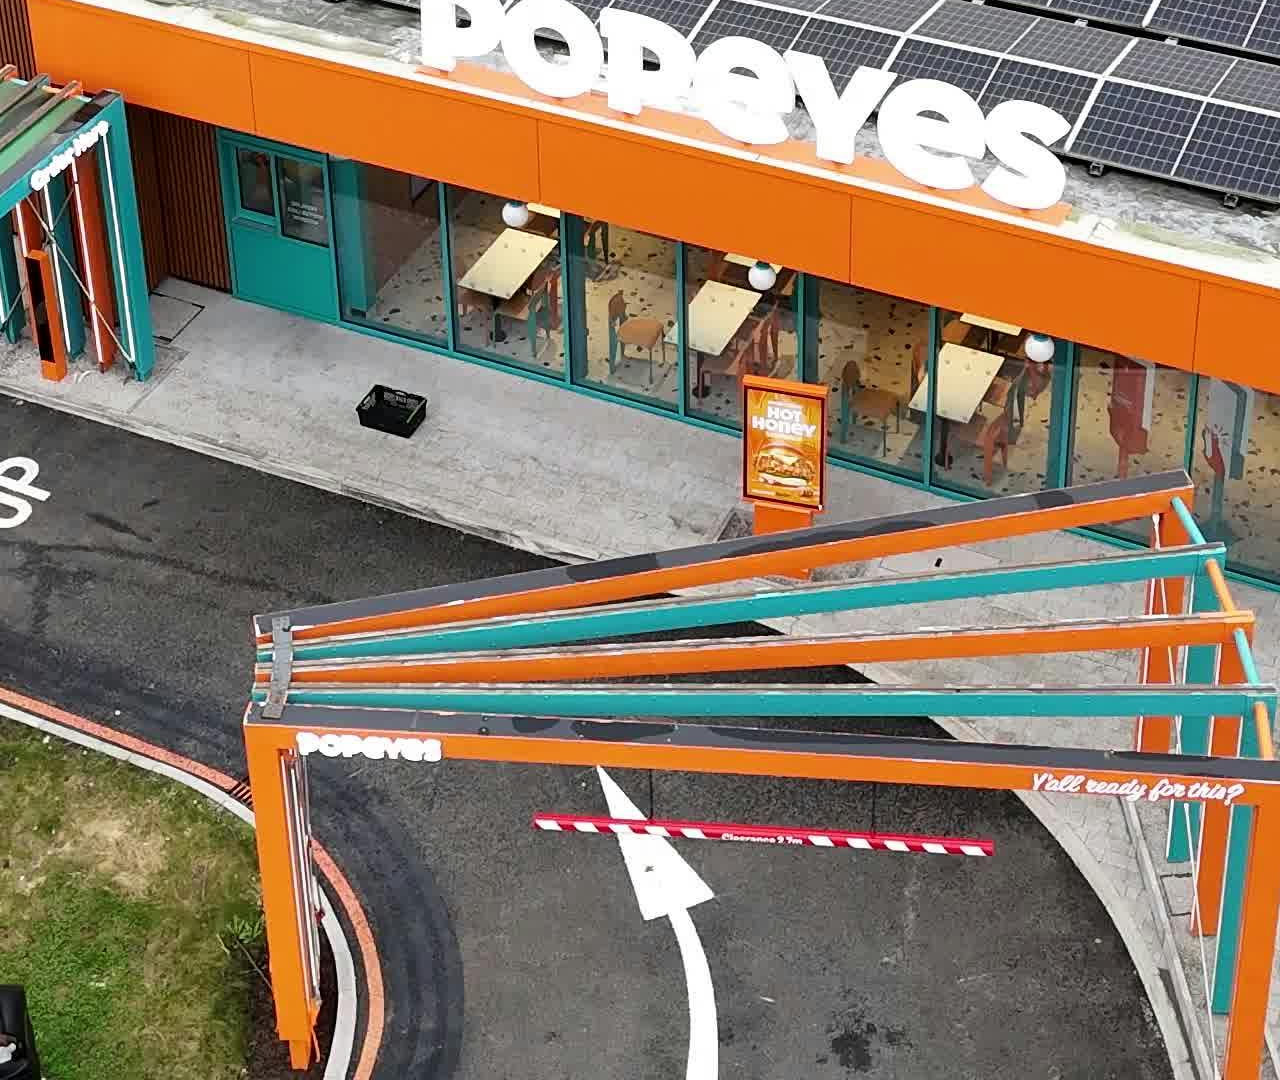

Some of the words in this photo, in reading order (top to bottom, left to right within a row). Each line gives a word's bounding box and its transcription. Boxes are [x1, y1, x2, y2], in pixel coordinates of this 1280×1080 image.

[767, 406, 801, 423] HOT
[1032, 773, 1085, 792] Y'all
[1086, 778, 1146, 801] ready
[1148, 778, 1187, 801] for
[1187, 782, 1246, 805] this?
